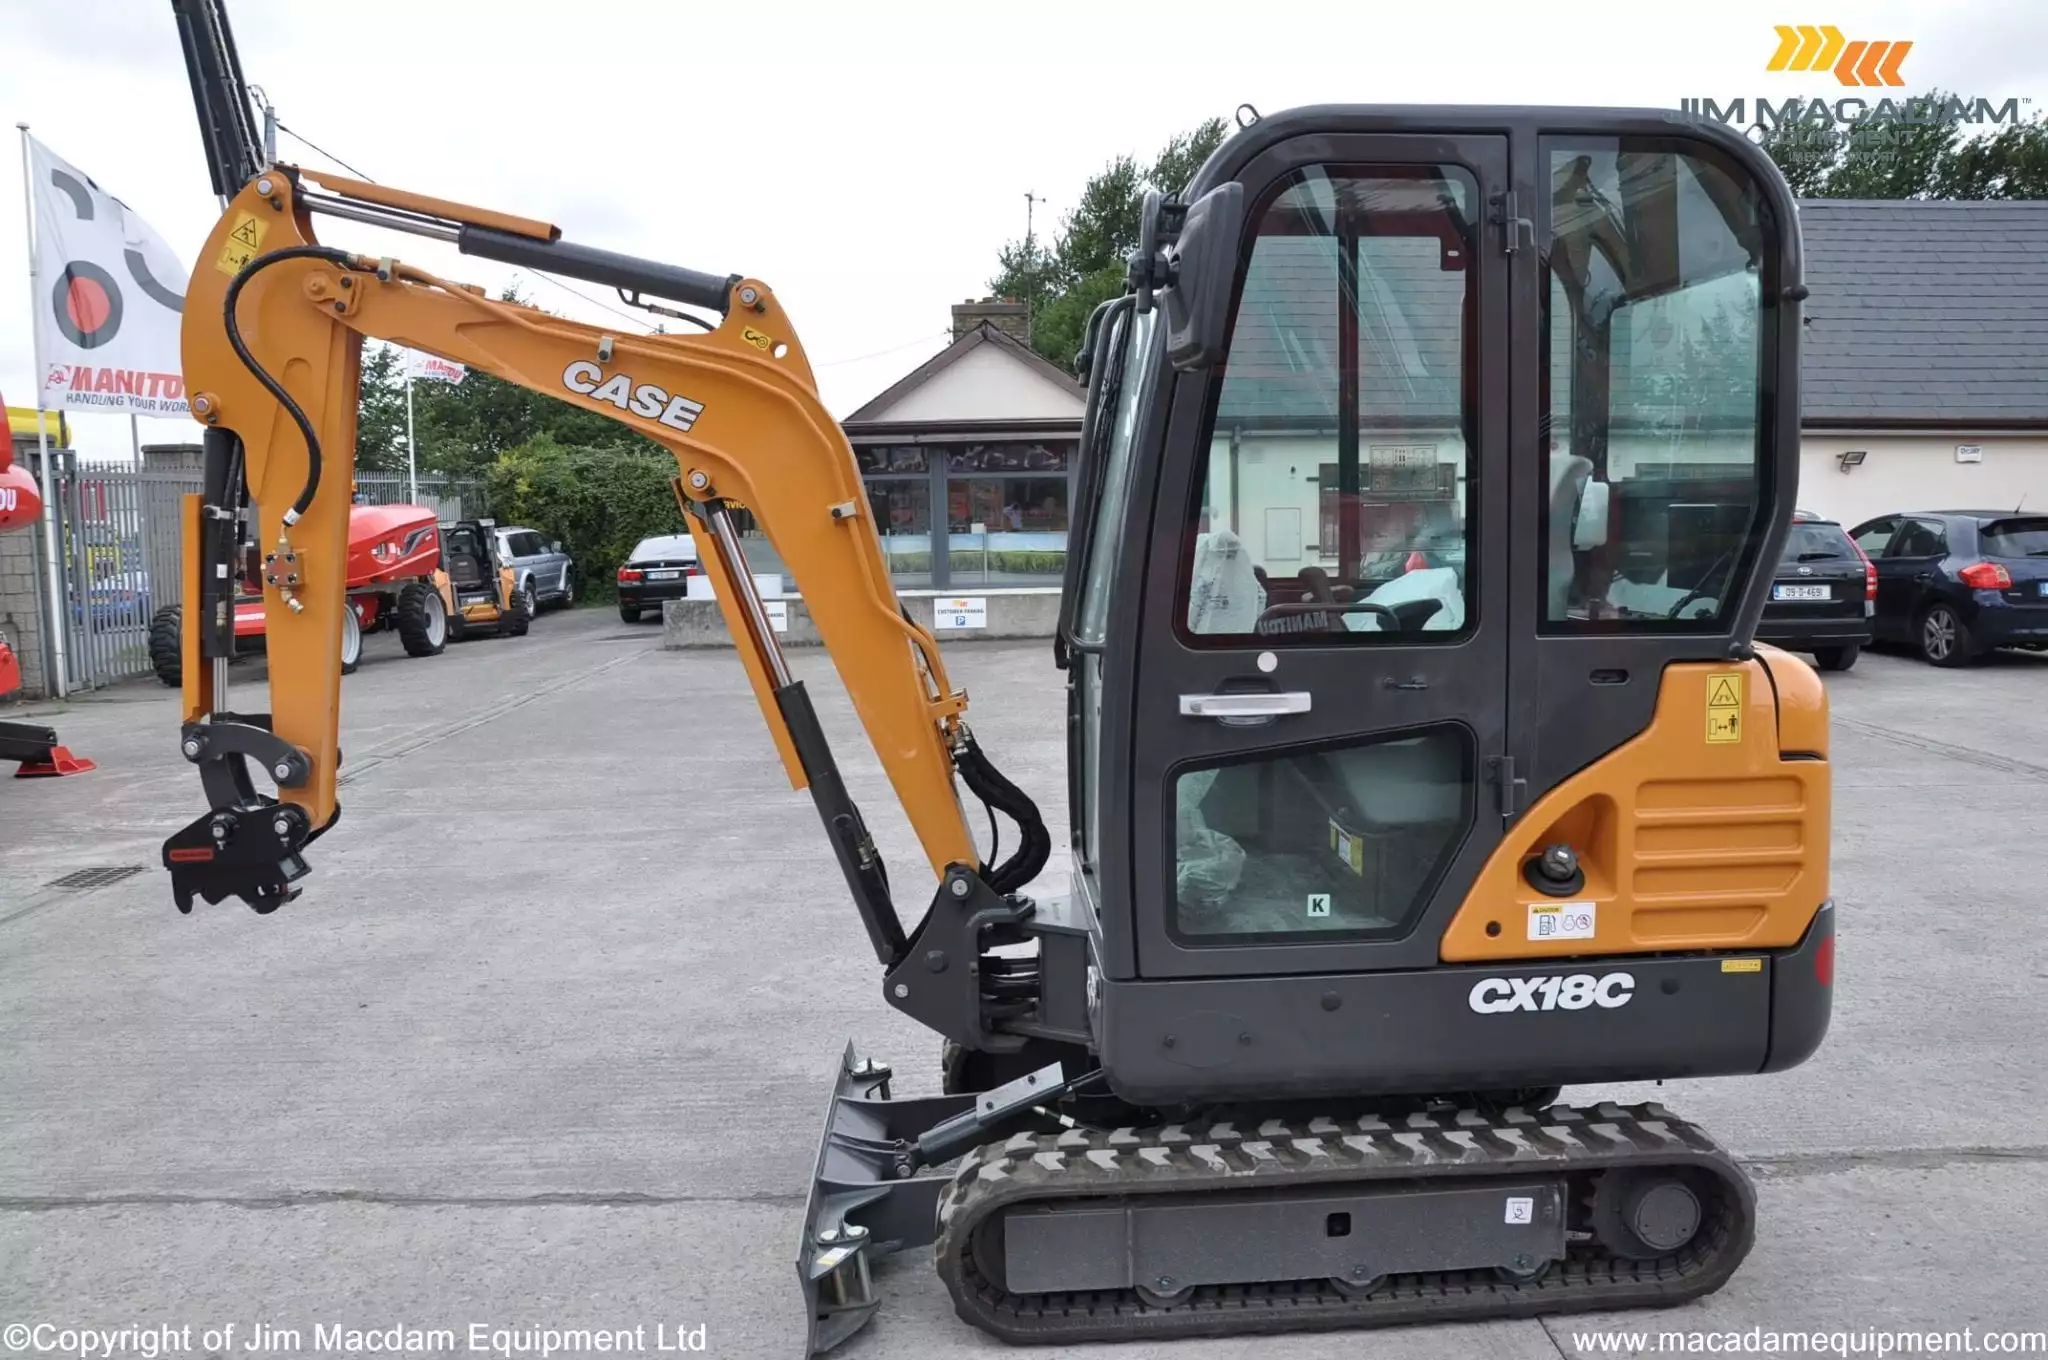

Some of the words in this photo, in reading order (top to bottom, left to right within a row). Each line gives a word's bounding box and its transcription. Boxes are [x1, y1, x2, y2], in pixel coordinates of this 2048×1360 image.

[69, 366, 185, 399] MANITO
[562, 359, 706, 433] CASE
[66, 392, 125, 407] HANDLING
[128, 395, 157, 411] YOUR
[1311, 897, 1325, 913] K
[1468, 972, 1635, 1014] CX18C
